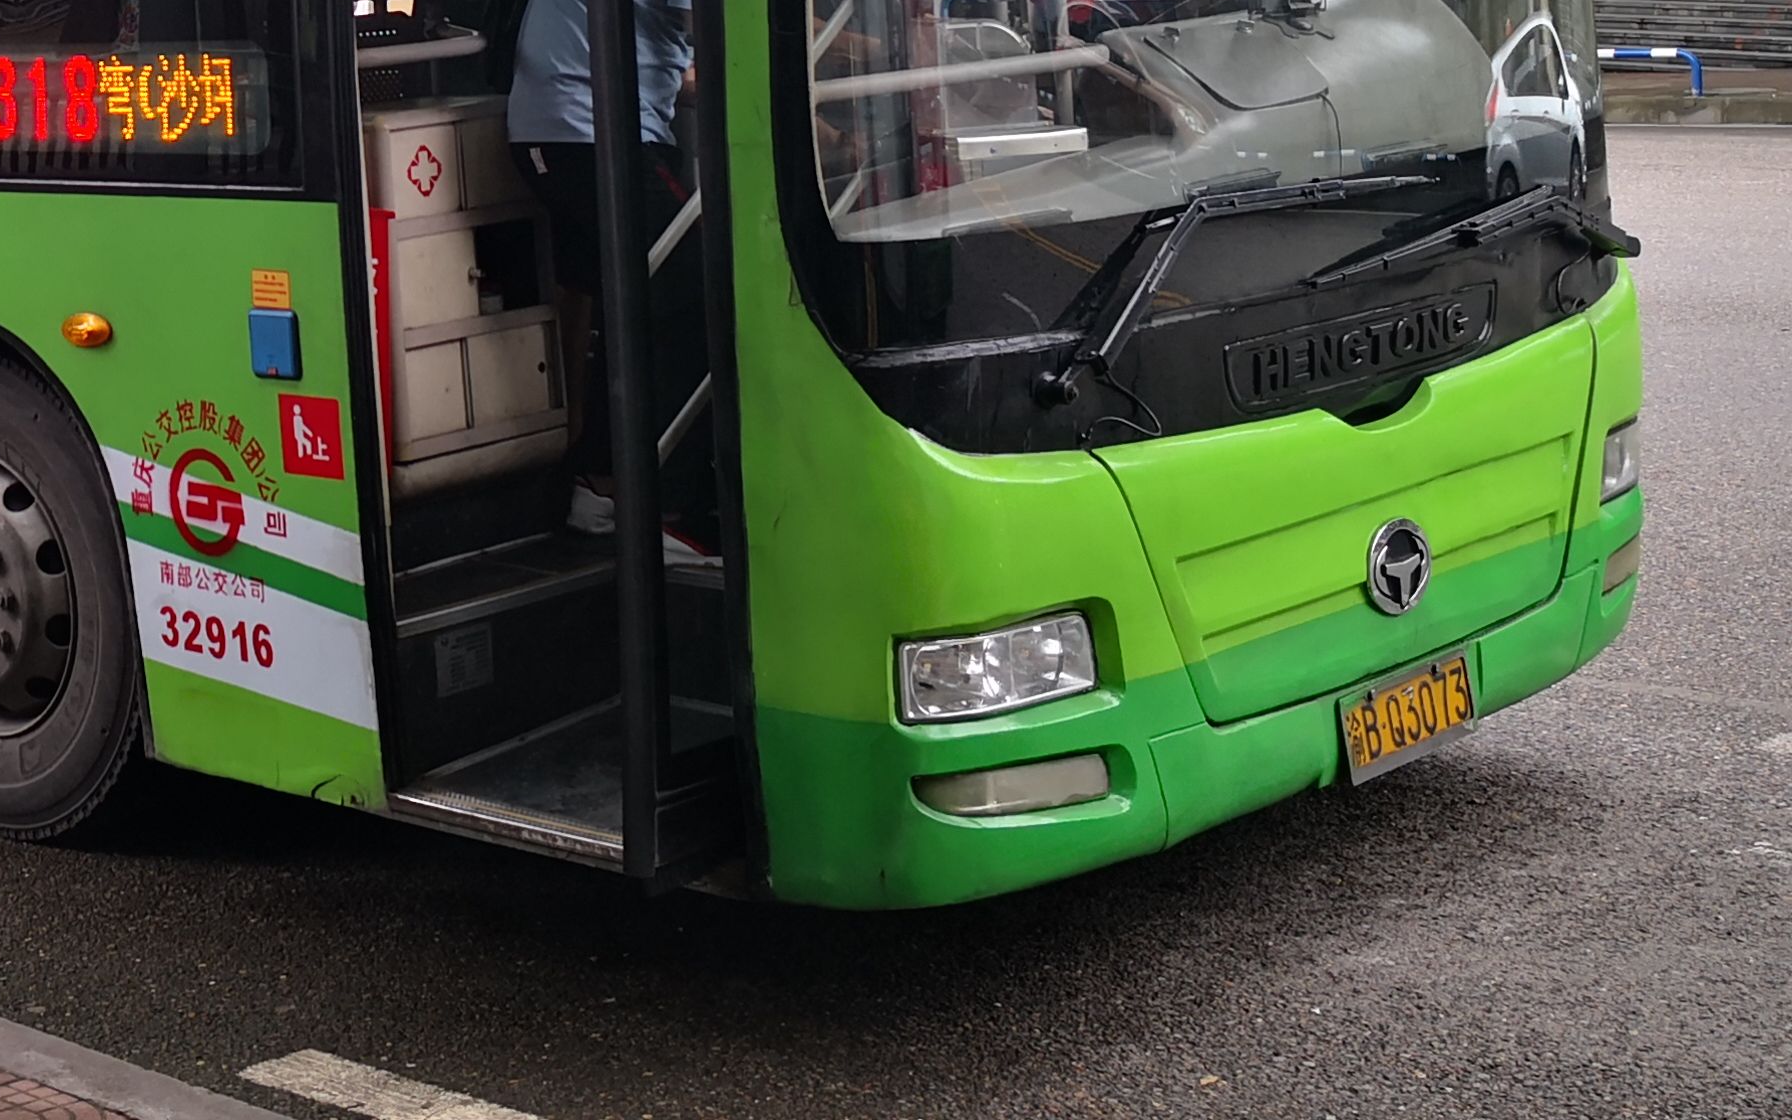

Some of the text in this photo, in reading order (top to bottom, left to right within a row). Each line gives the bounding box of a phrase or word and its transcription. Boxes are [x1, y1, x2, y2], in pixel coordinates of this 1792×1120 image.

[1251, 303, 1469, 397] HENGTONG
[160, 560, 266, 603] 南部公交公司
[159, 605, 274, 668] 32916
